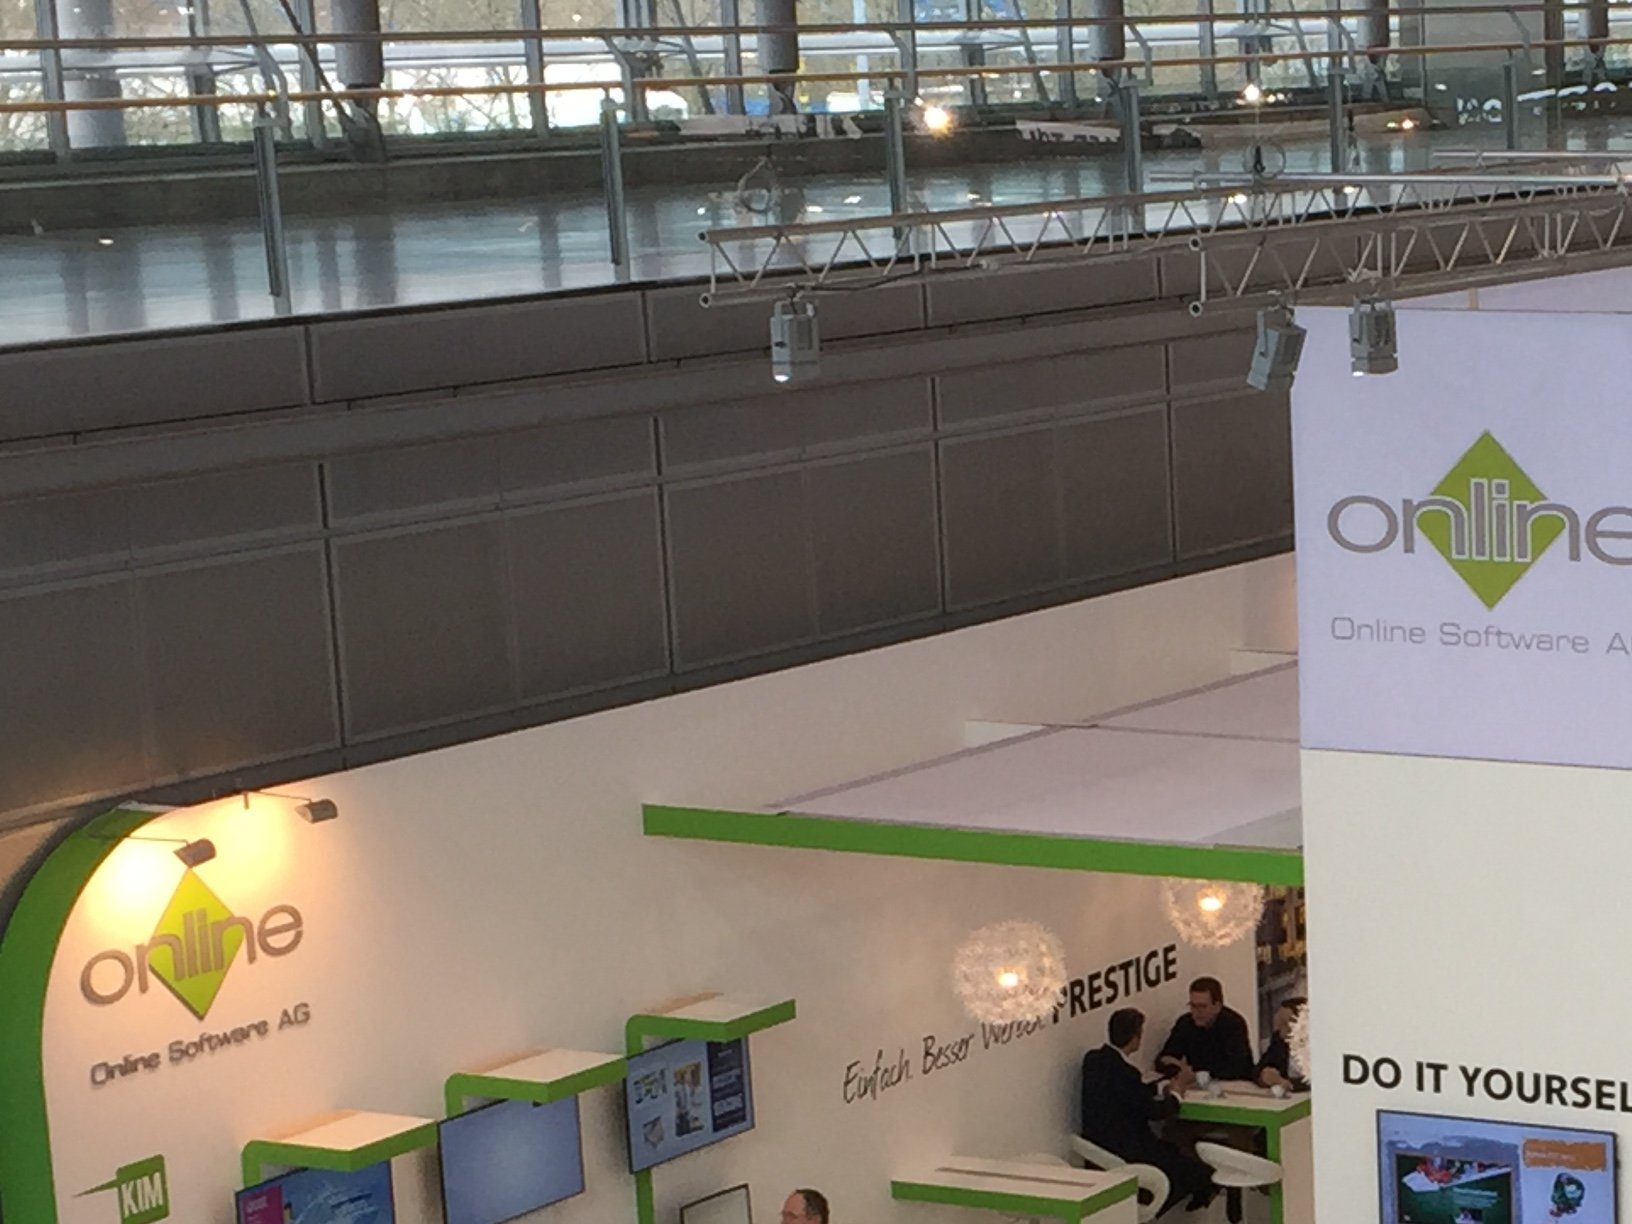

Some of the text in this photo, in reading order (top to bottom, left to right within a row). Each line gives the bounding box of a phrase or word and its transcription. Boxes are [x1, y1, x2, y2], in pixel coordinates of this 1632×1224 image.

[1331, 617, 1426, 644] Online
[1439, 622, 1589, 653] Software
[80, 904, 304, 1007] online
[90, 1002, 311, 1086] Online Software AG
[1342, 1054, 1401, 1089] DO
[1416, 1061, 1448, 1093] IT
[121, 1171, 163, 1219] KIM
